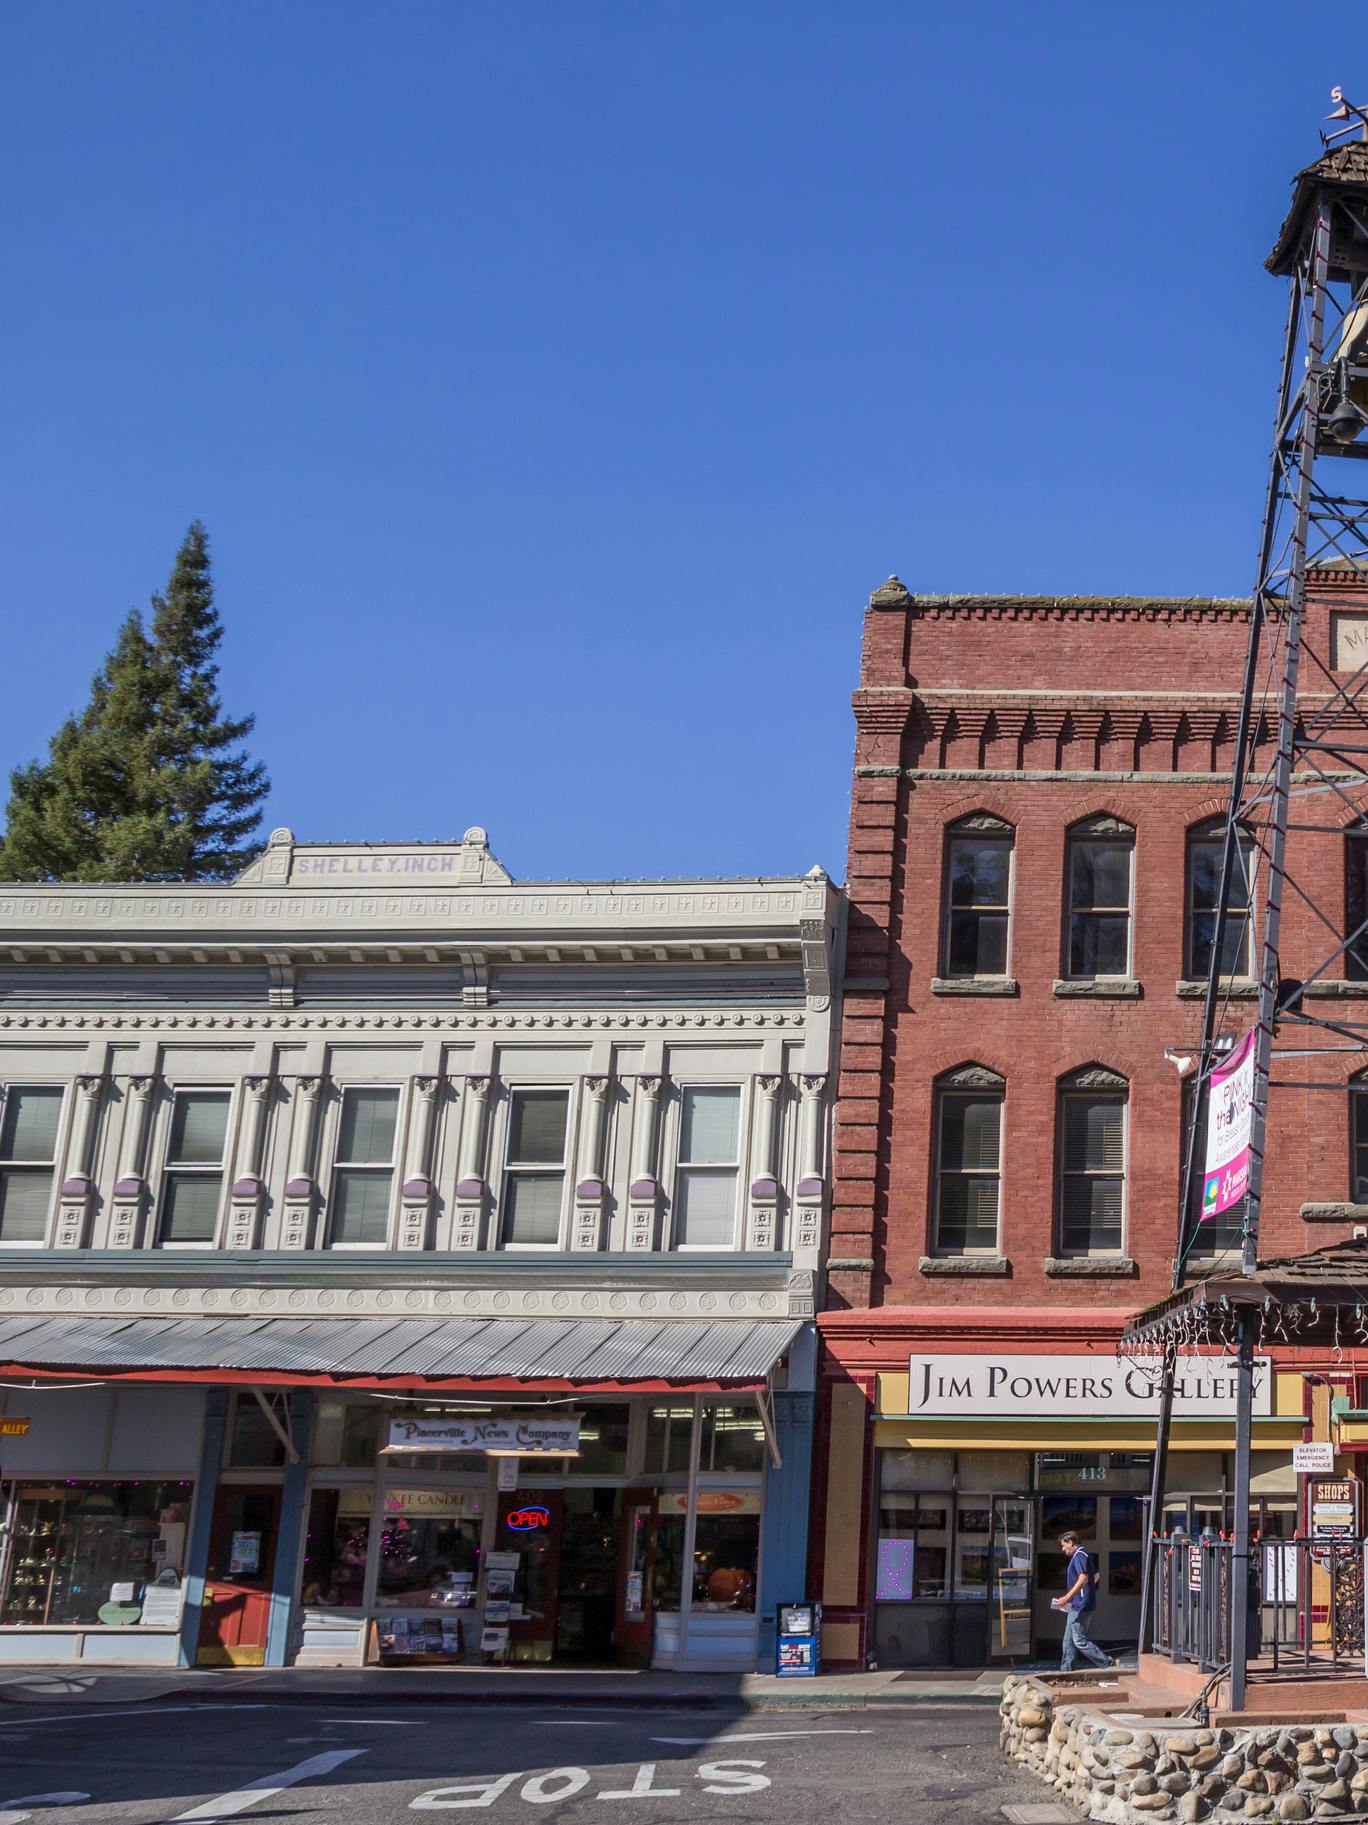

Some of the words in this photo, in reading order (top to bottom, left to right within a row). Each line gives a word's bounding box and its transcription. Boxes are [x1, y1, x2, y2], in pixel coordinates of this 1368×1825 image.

[918, 1363, 973, 1408] JIM
[986, 1366, 1113, 1399] POWERS
[461, 1422, 509, 1445] News
[516, 1424, 572, 1445] Company
[1078, 1467, 1105, 1480] 413
[417, 1494, 464, 1505] CANDLE
[1318, 1484, 1350, 1500] SHOPS
[508, 1512, 547, 1527] OPEN
[408, 1759, 772, 1810] STOP
